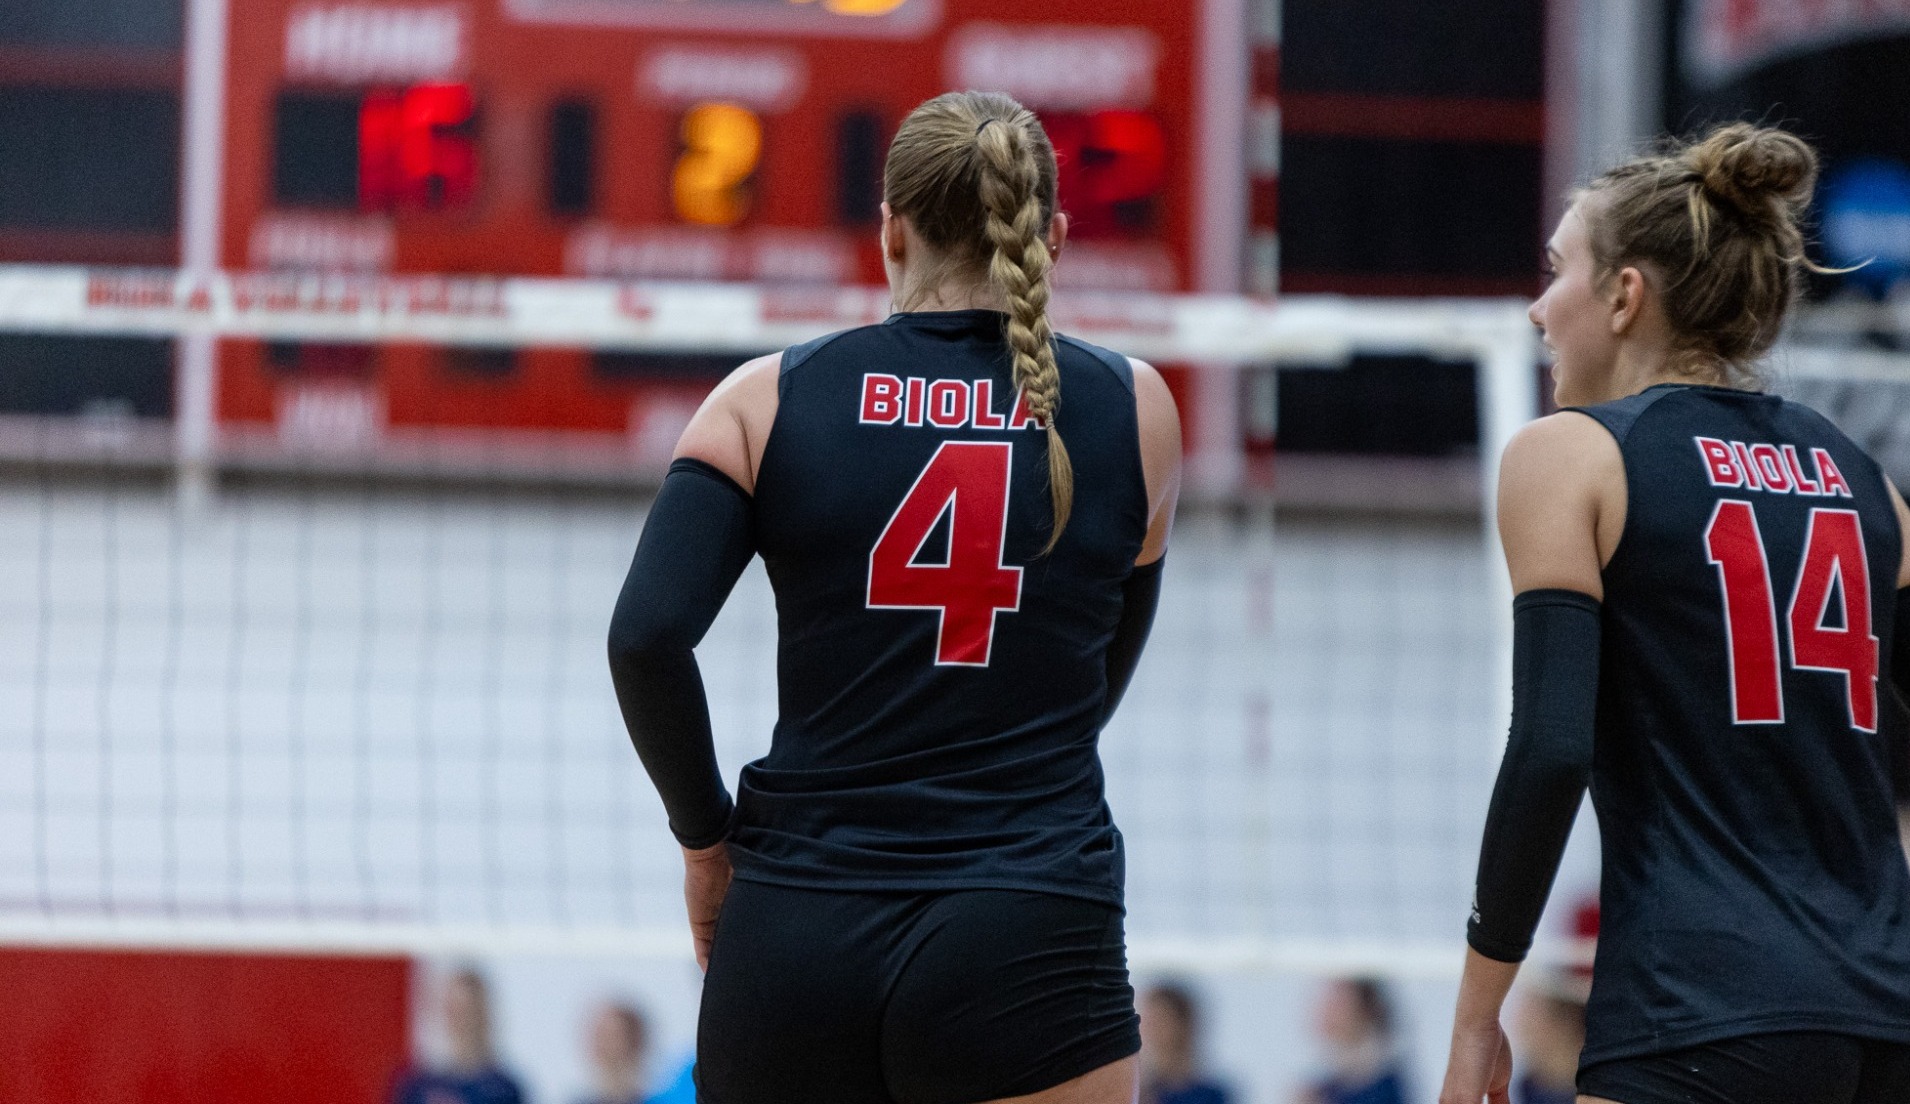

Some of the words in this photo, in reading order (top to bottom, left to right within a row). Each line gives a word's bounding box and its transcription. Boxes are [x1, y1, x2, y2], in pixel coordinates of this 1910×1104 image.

[859, 373, 1048, 430] BIOLA
[1694, 436, 1853, 498] BIOLA
[865, 440, 1024, 667] 4
[1703, 498, 1879, 734] 14
